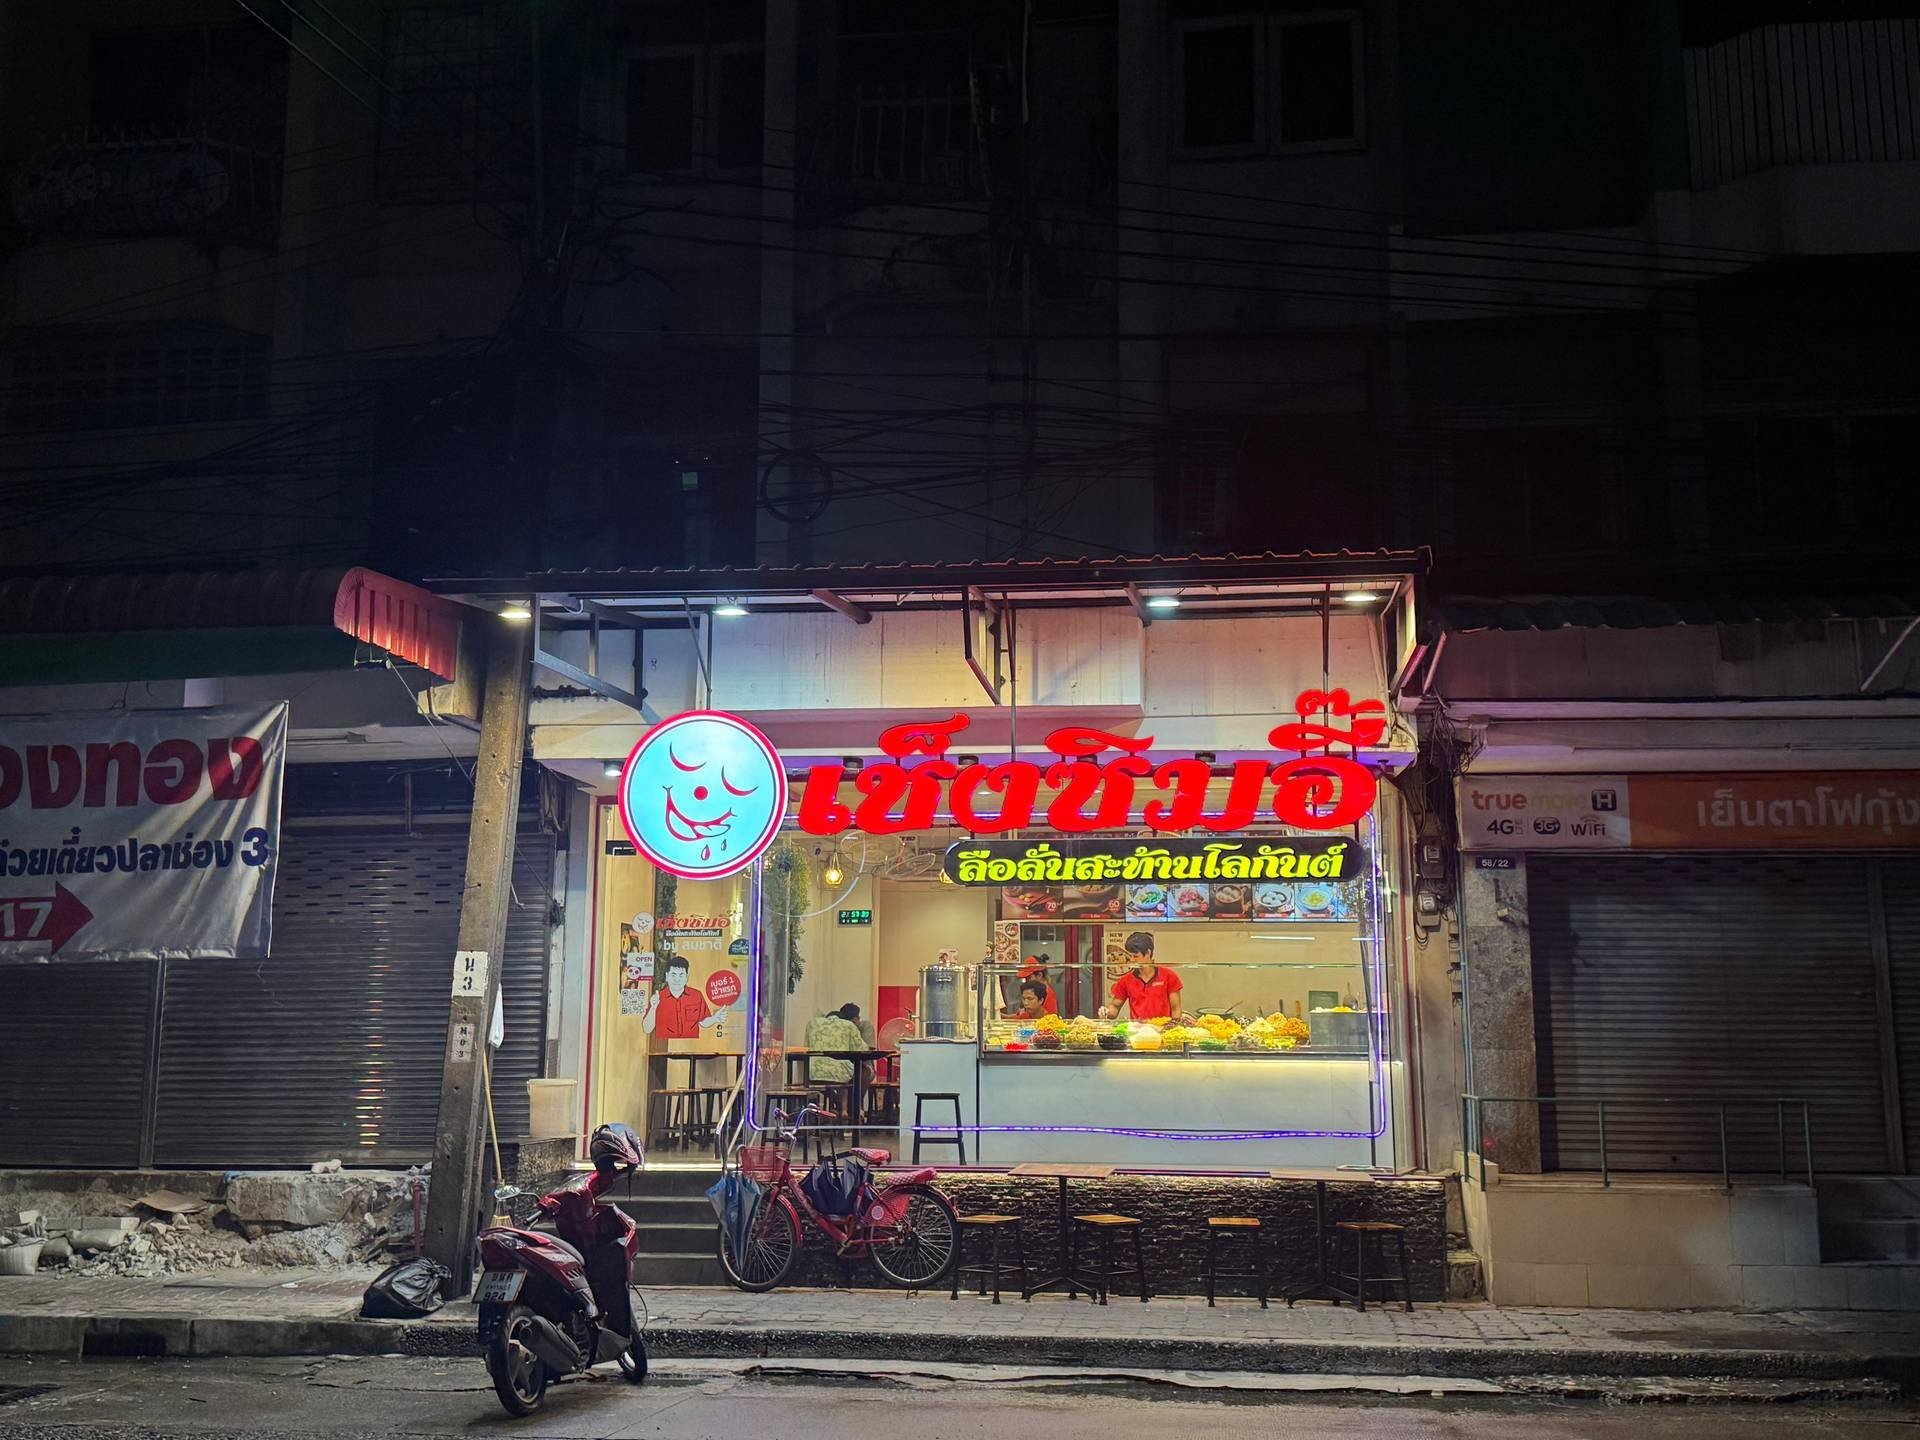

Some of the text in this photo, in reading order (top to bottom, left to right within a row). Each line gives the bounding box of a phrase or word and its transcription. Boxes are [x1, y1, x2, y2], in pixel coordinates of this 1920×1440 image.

[798, 688, 1386, 834] เช็งซิมอี๊
[1487, 819, 1514, 835] 4G
[241, 827, 269, 867] 3
[958, 843, 1348, 882] ลือลั่นสะท้านโลกันต์
